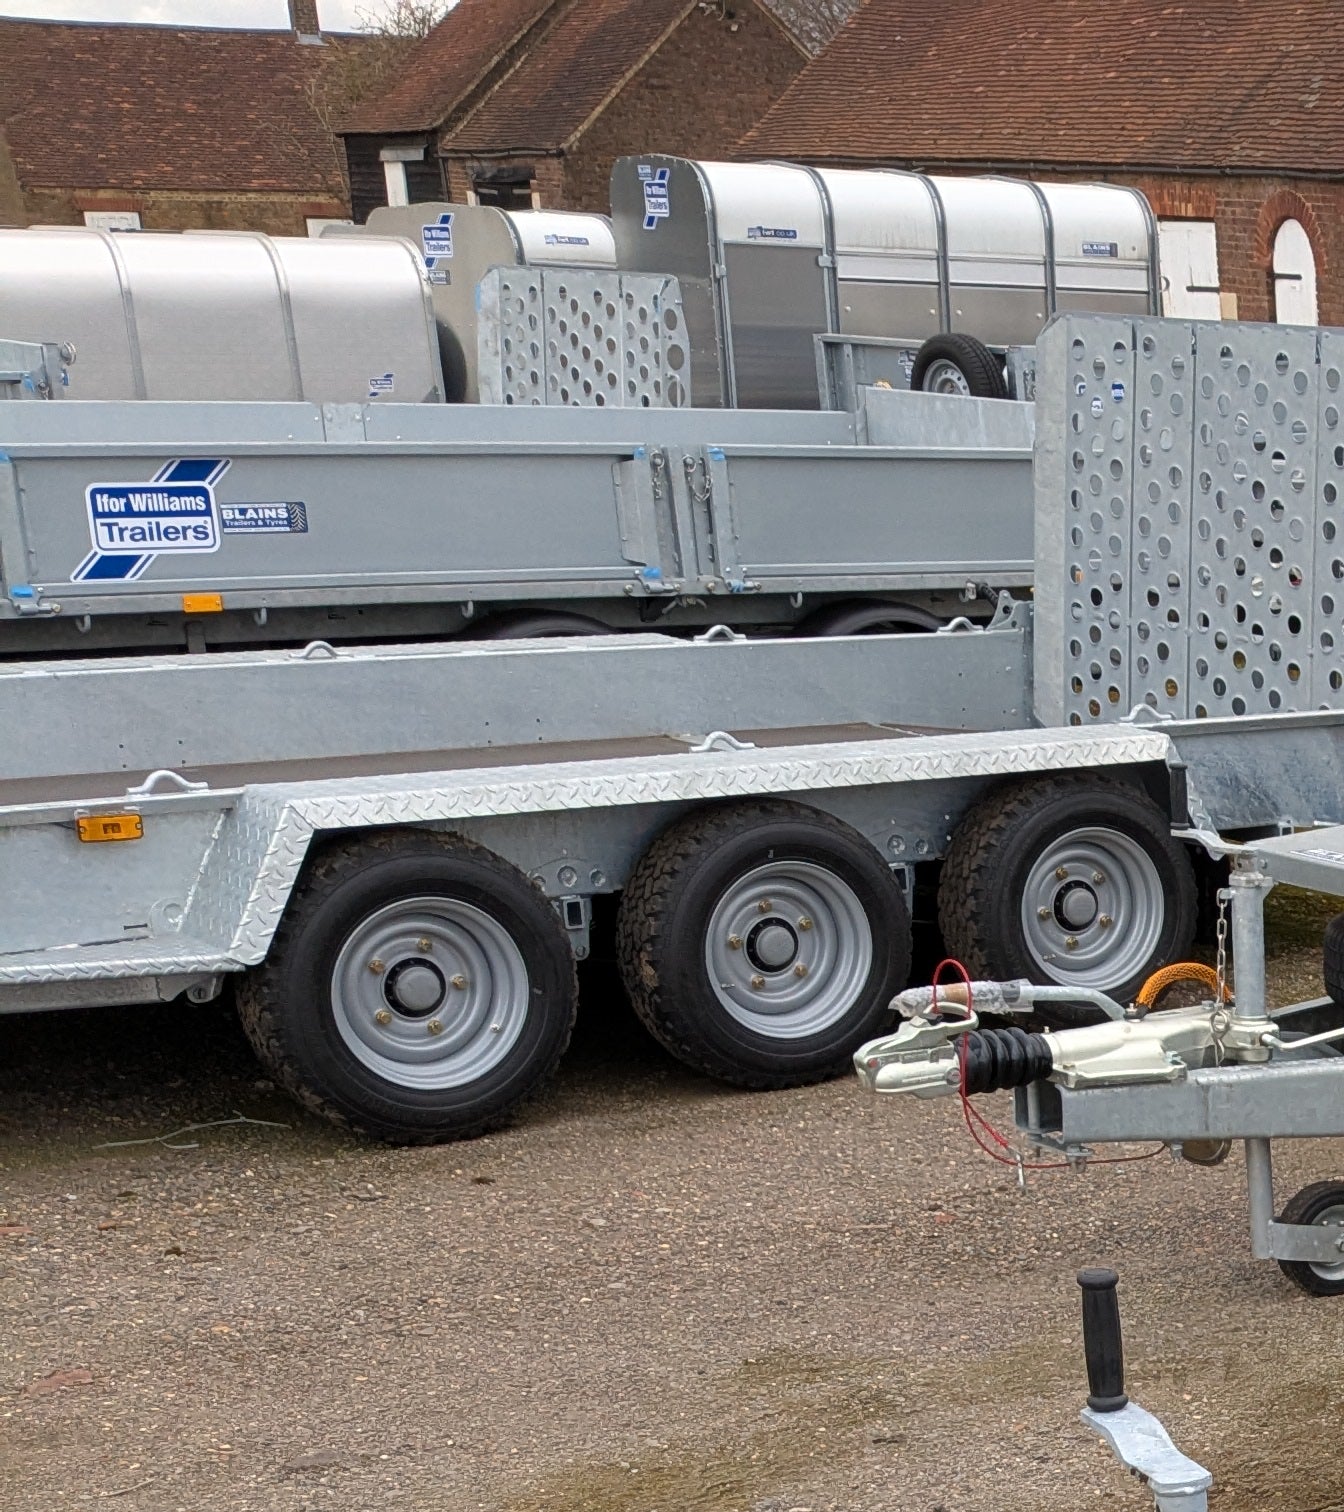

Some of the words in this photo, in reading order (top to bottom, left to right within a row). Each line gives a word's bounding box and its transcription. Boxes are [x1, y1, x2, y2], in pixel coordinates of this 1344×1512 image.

[426, 242, 450, 252] Trailers
[96, 493, 127, 512] Ifor
[128, 492, 206, 512] Williams
[222, 508, 288, 520] BLAINS
[100, 521, 210, 542] Trailers
